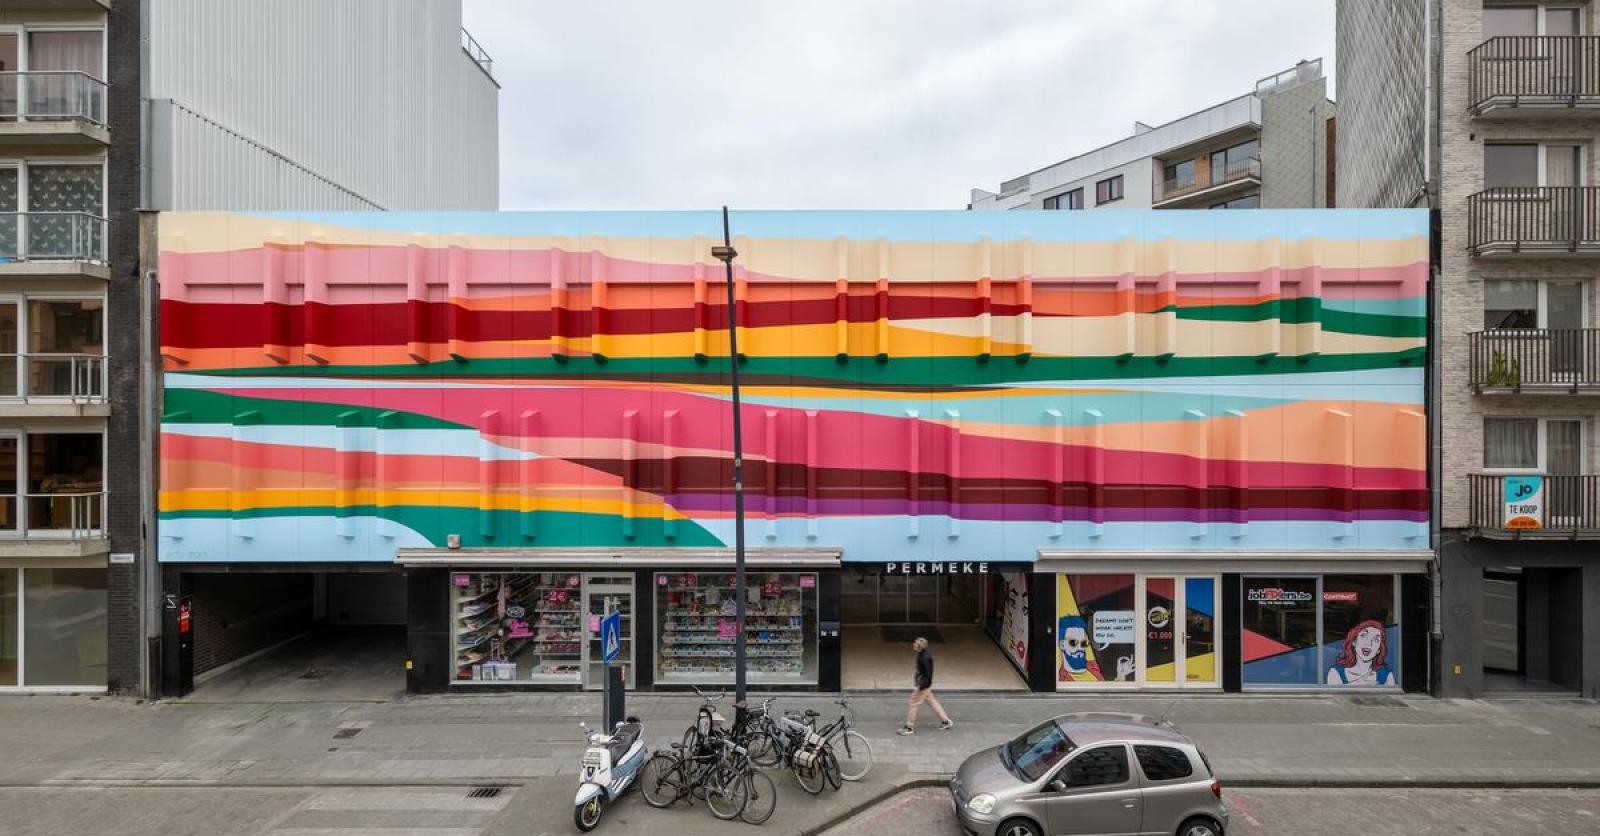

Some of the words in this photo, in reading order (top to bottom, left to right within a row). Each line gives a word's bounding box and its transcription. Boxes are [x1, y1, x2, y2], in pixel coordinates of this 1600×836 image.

[1509, 504, 1518, 514] TE
[1519, 504, 1537, 514] KOOP
[887, 562, 989, 574] PERMEKE
[550, 591, 567, 602] 2€
